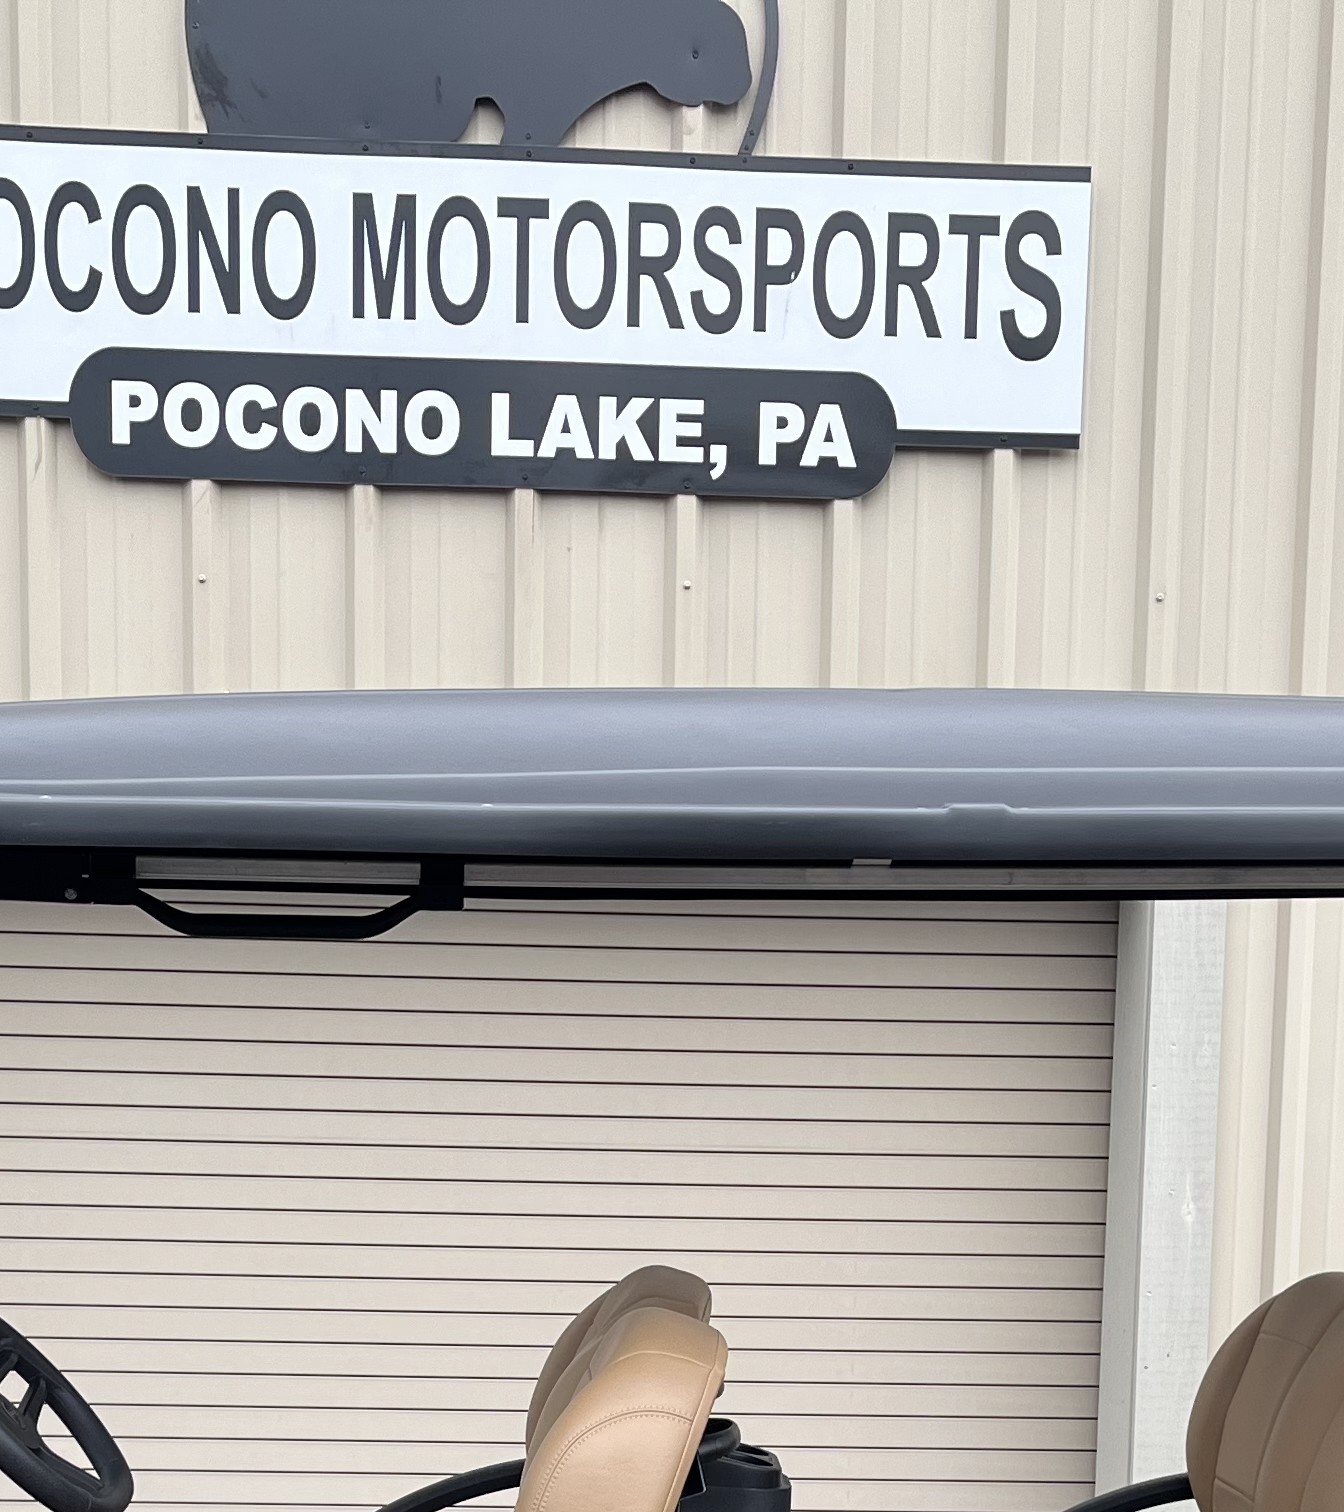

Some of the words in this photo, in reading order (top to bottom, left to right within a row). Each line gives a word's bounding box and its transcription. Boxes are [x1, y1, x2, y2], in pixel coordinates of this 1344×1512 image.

[352, 191, 1062, 362] MOTORSPORTS
[111, 379, 461, 456] POCONO
[490, 392, 728, 481] LAKE,
[758, 401, 857, 469] PA
